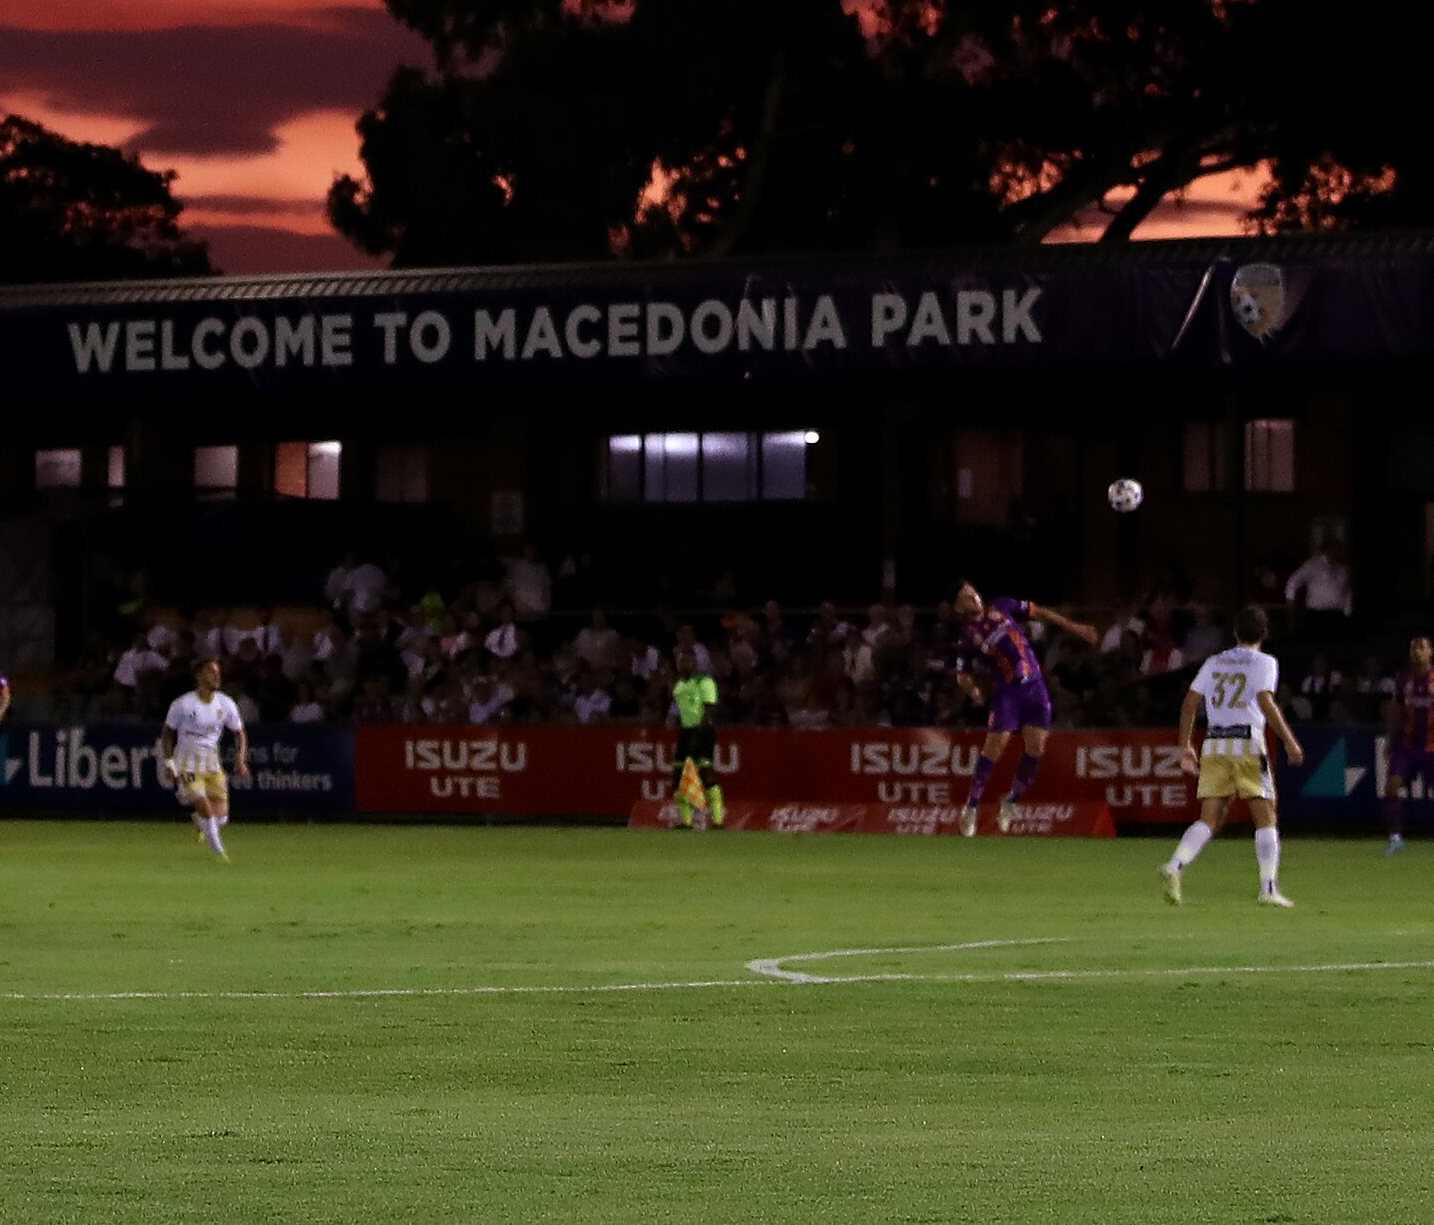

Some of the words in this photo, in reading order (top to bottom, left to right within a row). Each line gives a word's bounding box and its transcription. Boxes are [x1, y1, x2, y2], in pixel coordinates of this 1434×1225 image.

[67, 316, 354, 374] WELCOME
[374, 309, 452, 365] TO
[473, 295, 848, 362] MACEDONIA
[870, 287, 1044, 348] PARK
[1211, 671, 1247, 710] 32
[27, 728, 176, 790] Libert
[404, 739, 528, 773] ISUZU
[615, 742, 740, 774] ISUU
[850, 742, 981, 776] ISUZU
[1075, 745, 1184, 780] ISUZ
[430, 776, 501, 800] UTE
[877, 780, 952, 804] UTE
[1105, 783, 1188, 808] UTE
